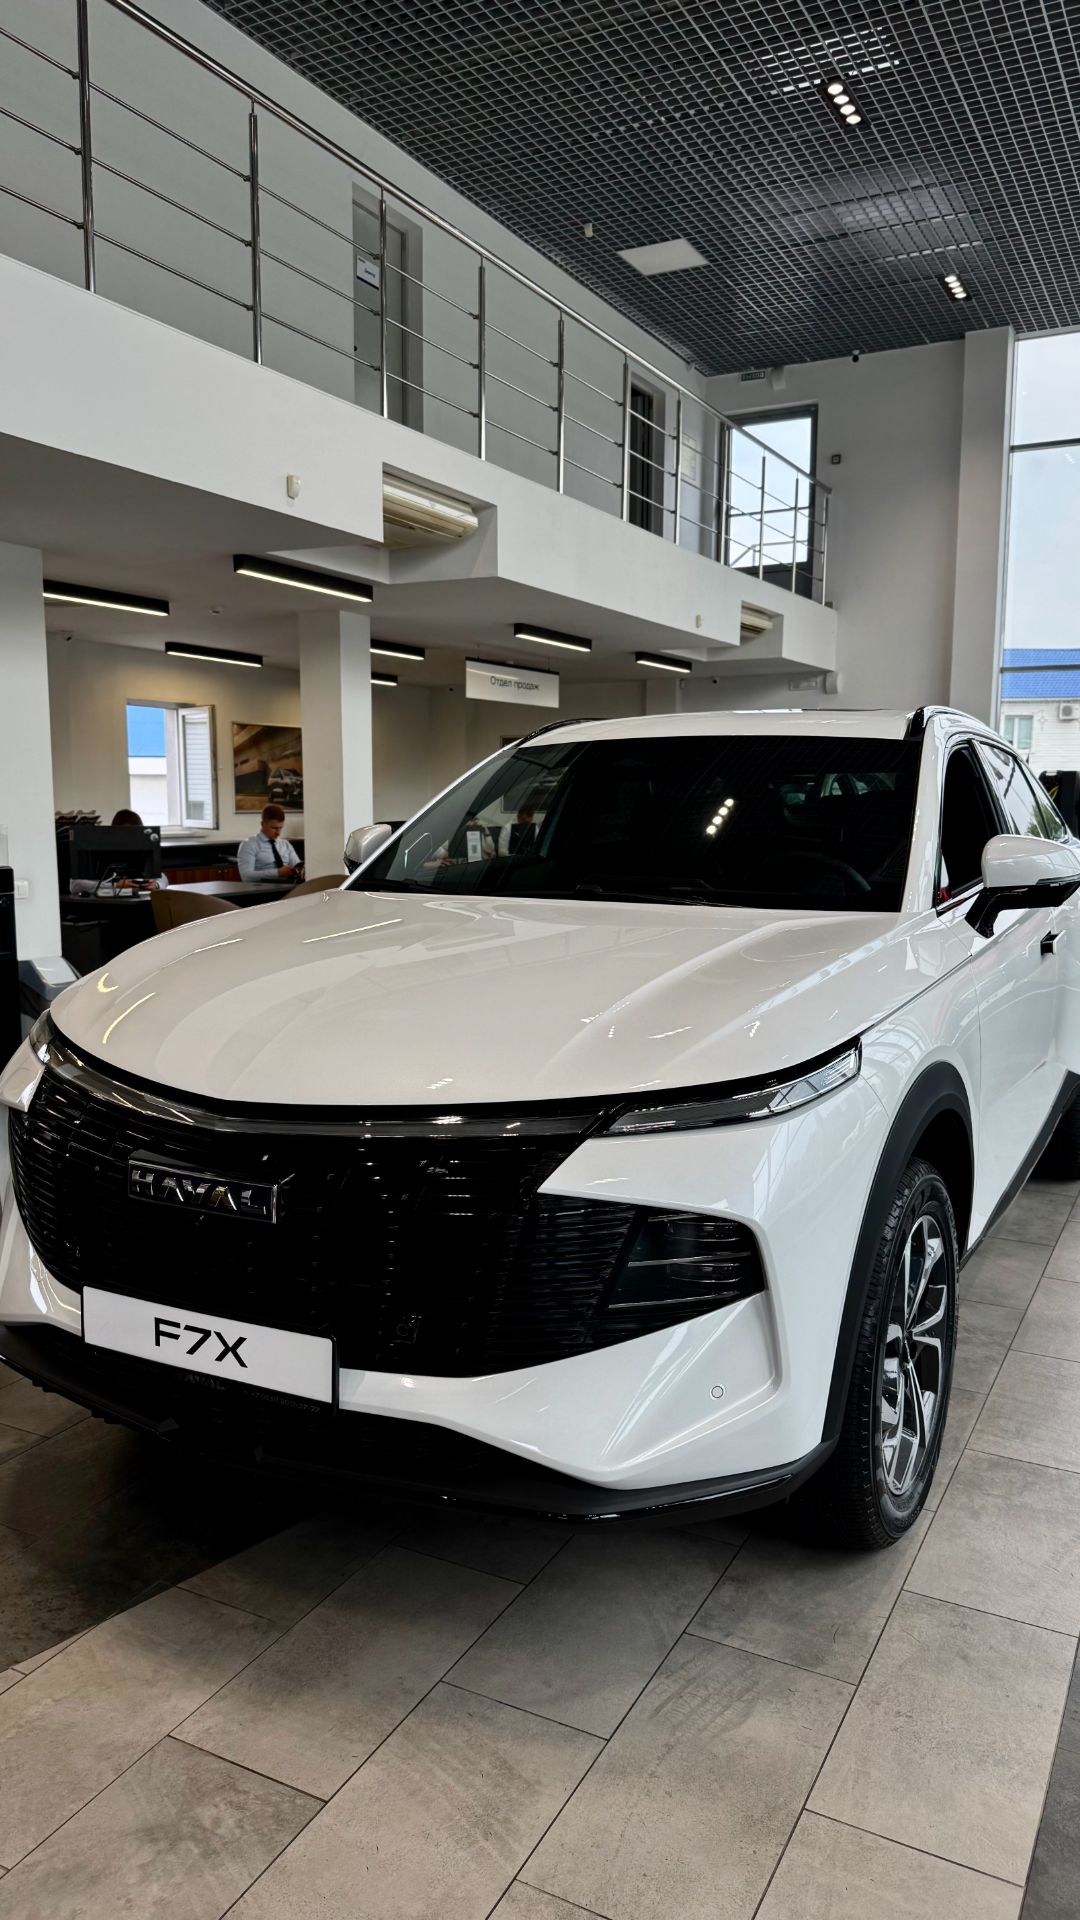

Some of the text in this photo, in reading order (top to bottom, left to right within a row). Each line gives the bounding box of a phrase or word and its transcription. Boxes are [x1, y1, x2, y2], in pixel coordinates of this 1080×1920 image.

[490, 675, 540, 691] Отдел продаж
[131, 1169, 268, 1216] HAVAL
[154, 1316, 248, 1369] F7X
